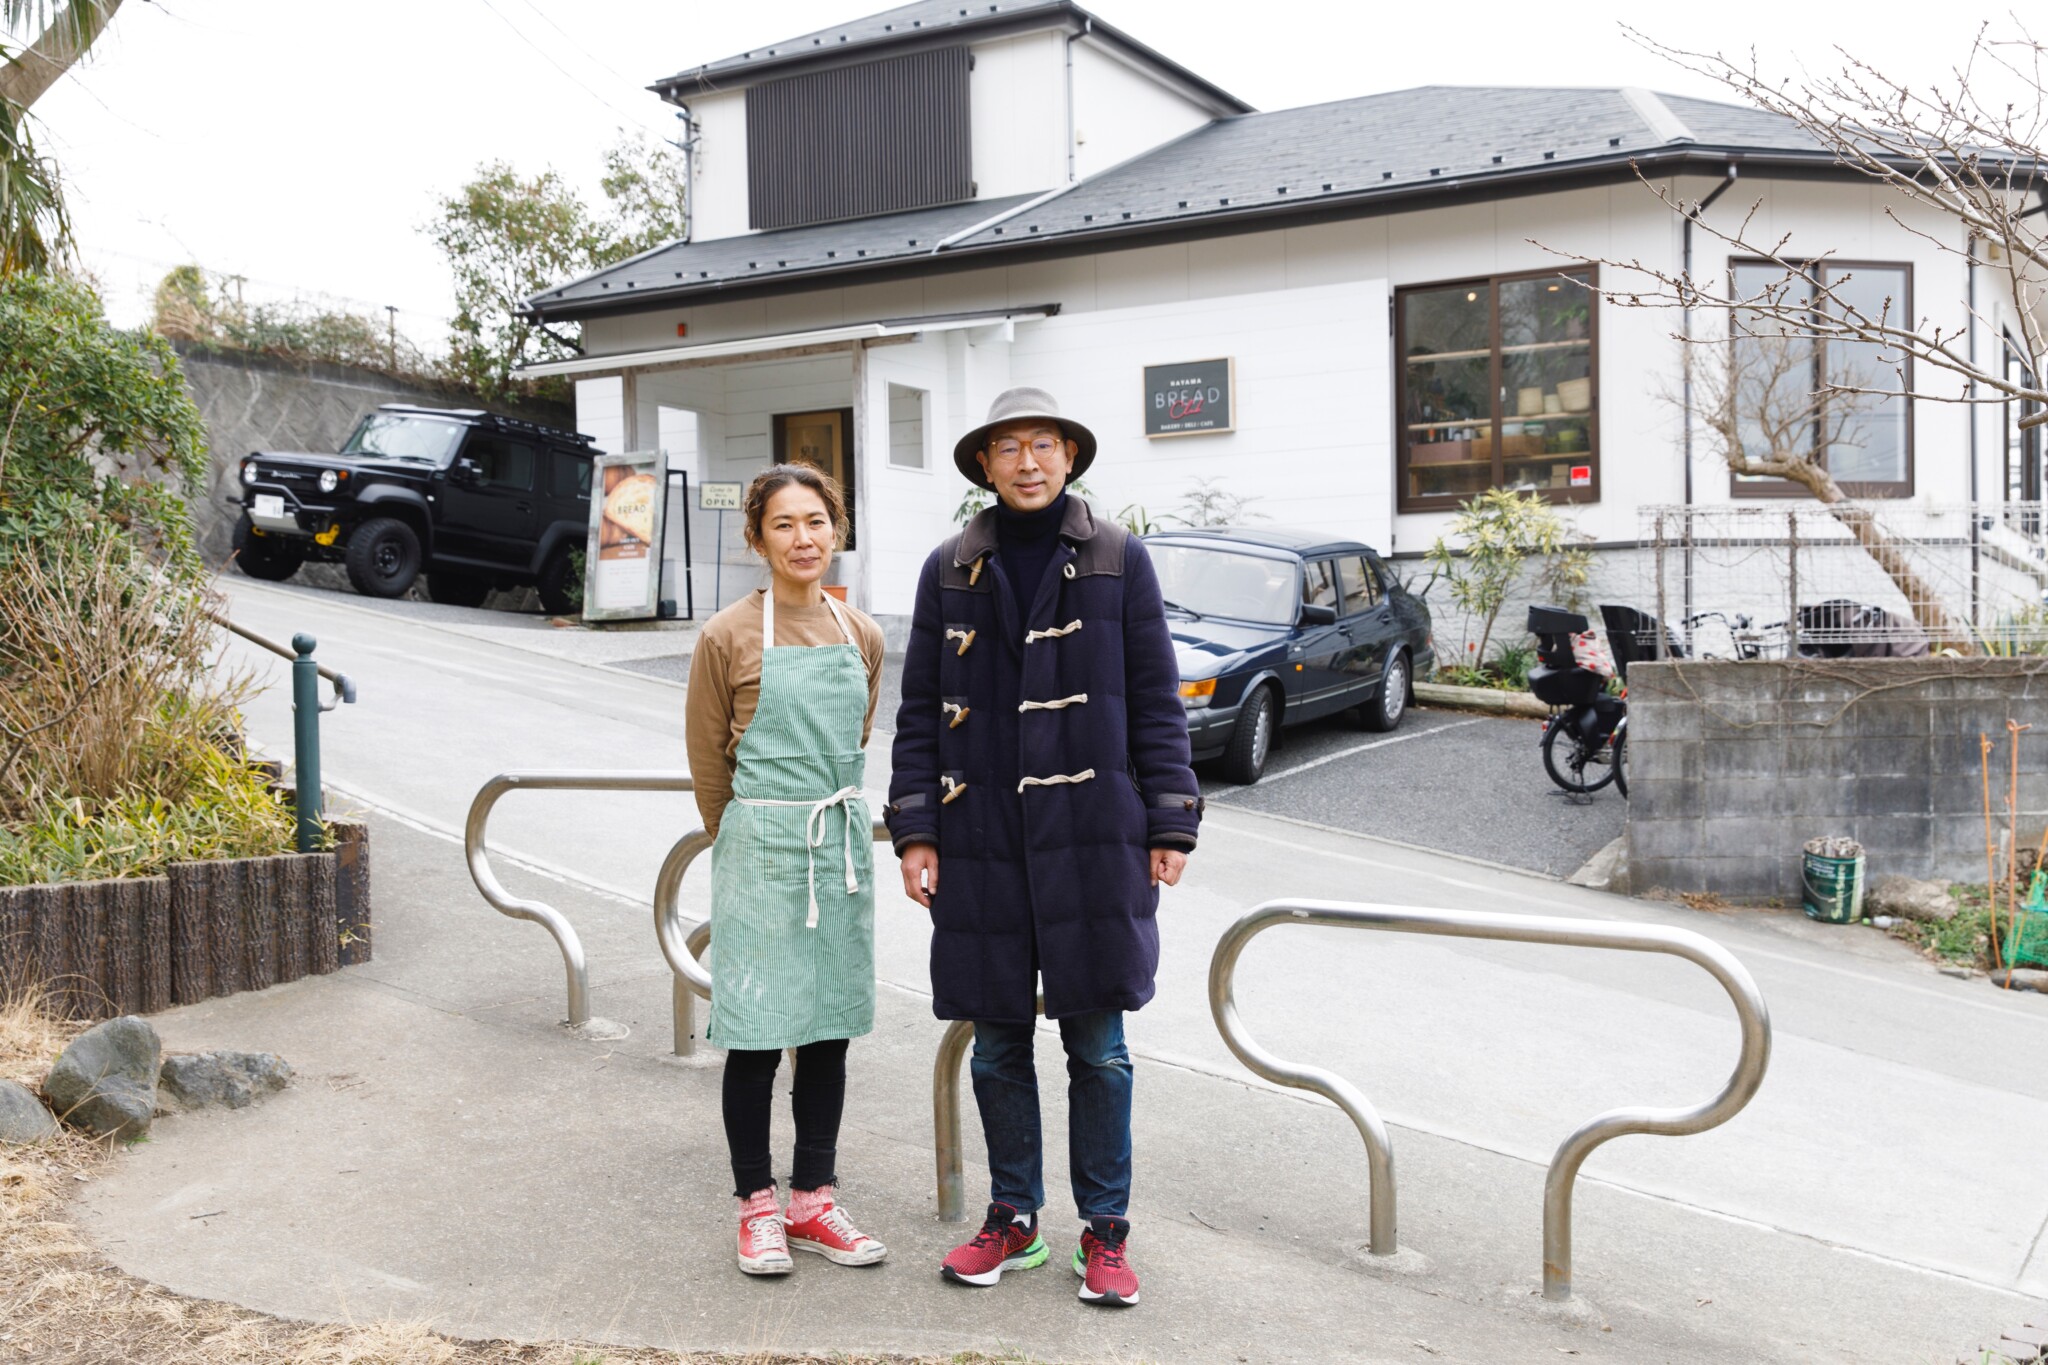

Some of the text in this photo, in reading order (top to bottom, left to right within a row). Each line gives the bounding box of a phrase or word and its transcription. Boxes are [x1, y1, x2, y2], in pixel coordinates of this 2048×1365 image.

[1155, 387, 1220, 408] BREAD
[705, 498, 735, 506] OPEN
[617, 504, 646, 515] BREAD
